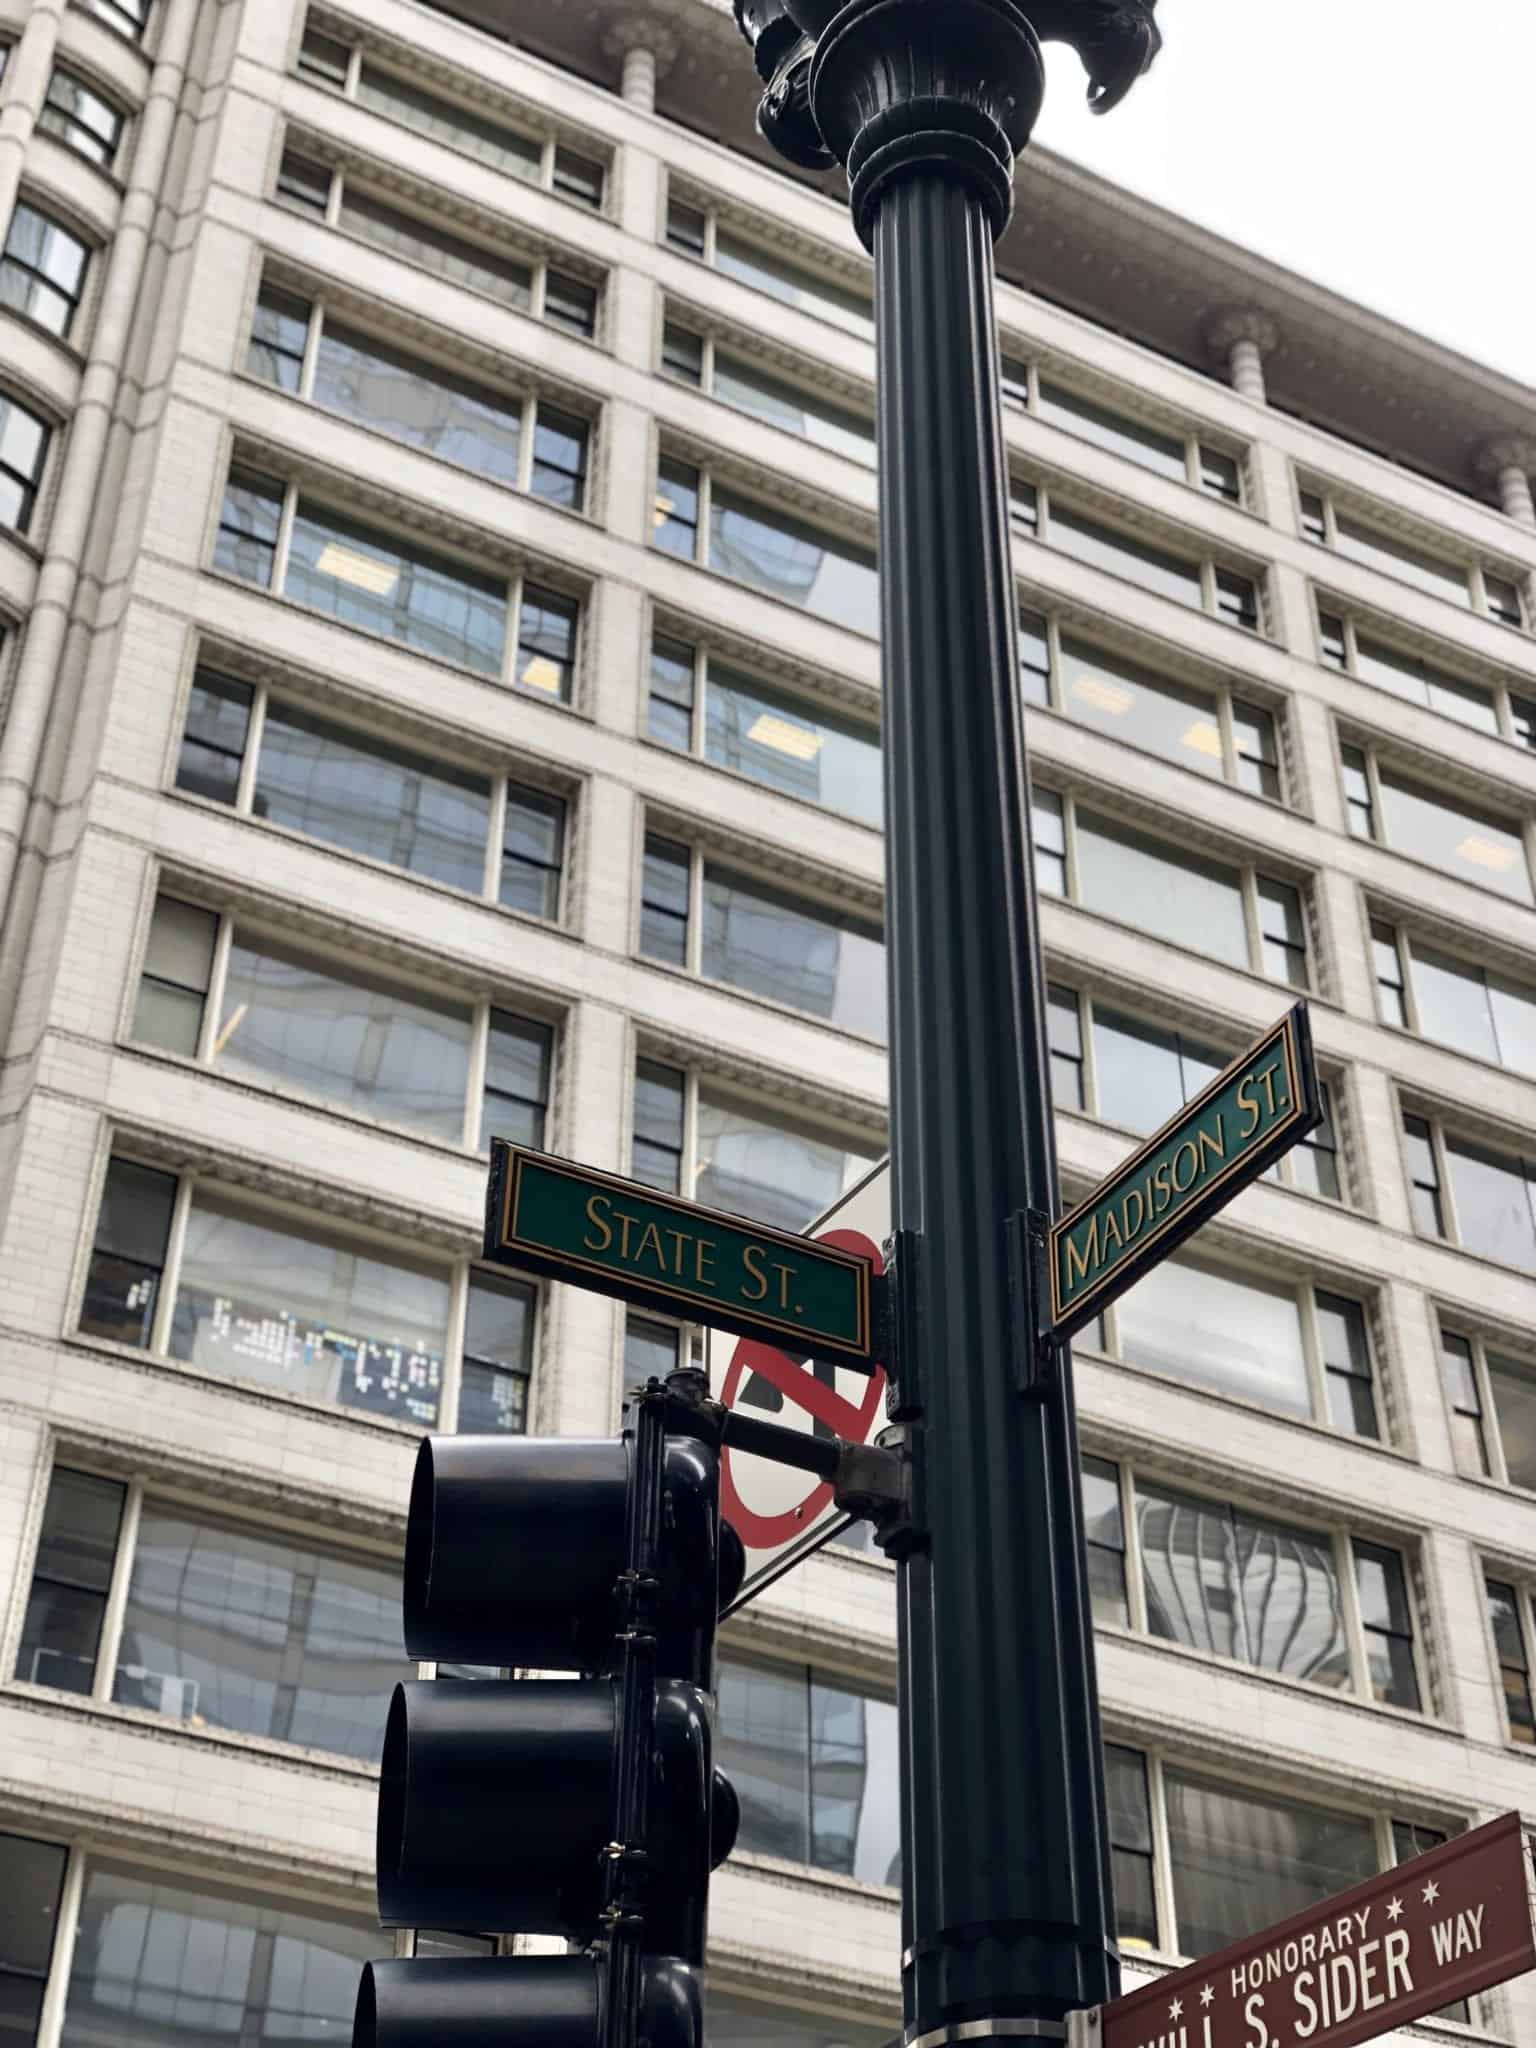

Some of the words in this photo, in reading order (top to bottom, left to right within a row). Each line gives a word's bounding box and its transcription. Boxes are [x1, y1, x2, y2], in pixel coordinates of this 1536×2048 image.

[1065, 1113, 1224, 1289] MADISON
[1237, 1063, 1289, 1138] ST.
[584, 1194, 716, 1288] STATE
[741, 1245, 803, 1313] ST.
[1231, 1906, 1371, 1998] HONORARY
[1294, 1929, 1413, 2038] SIDER
[1432, 1904, 1485, 1967] WAY
